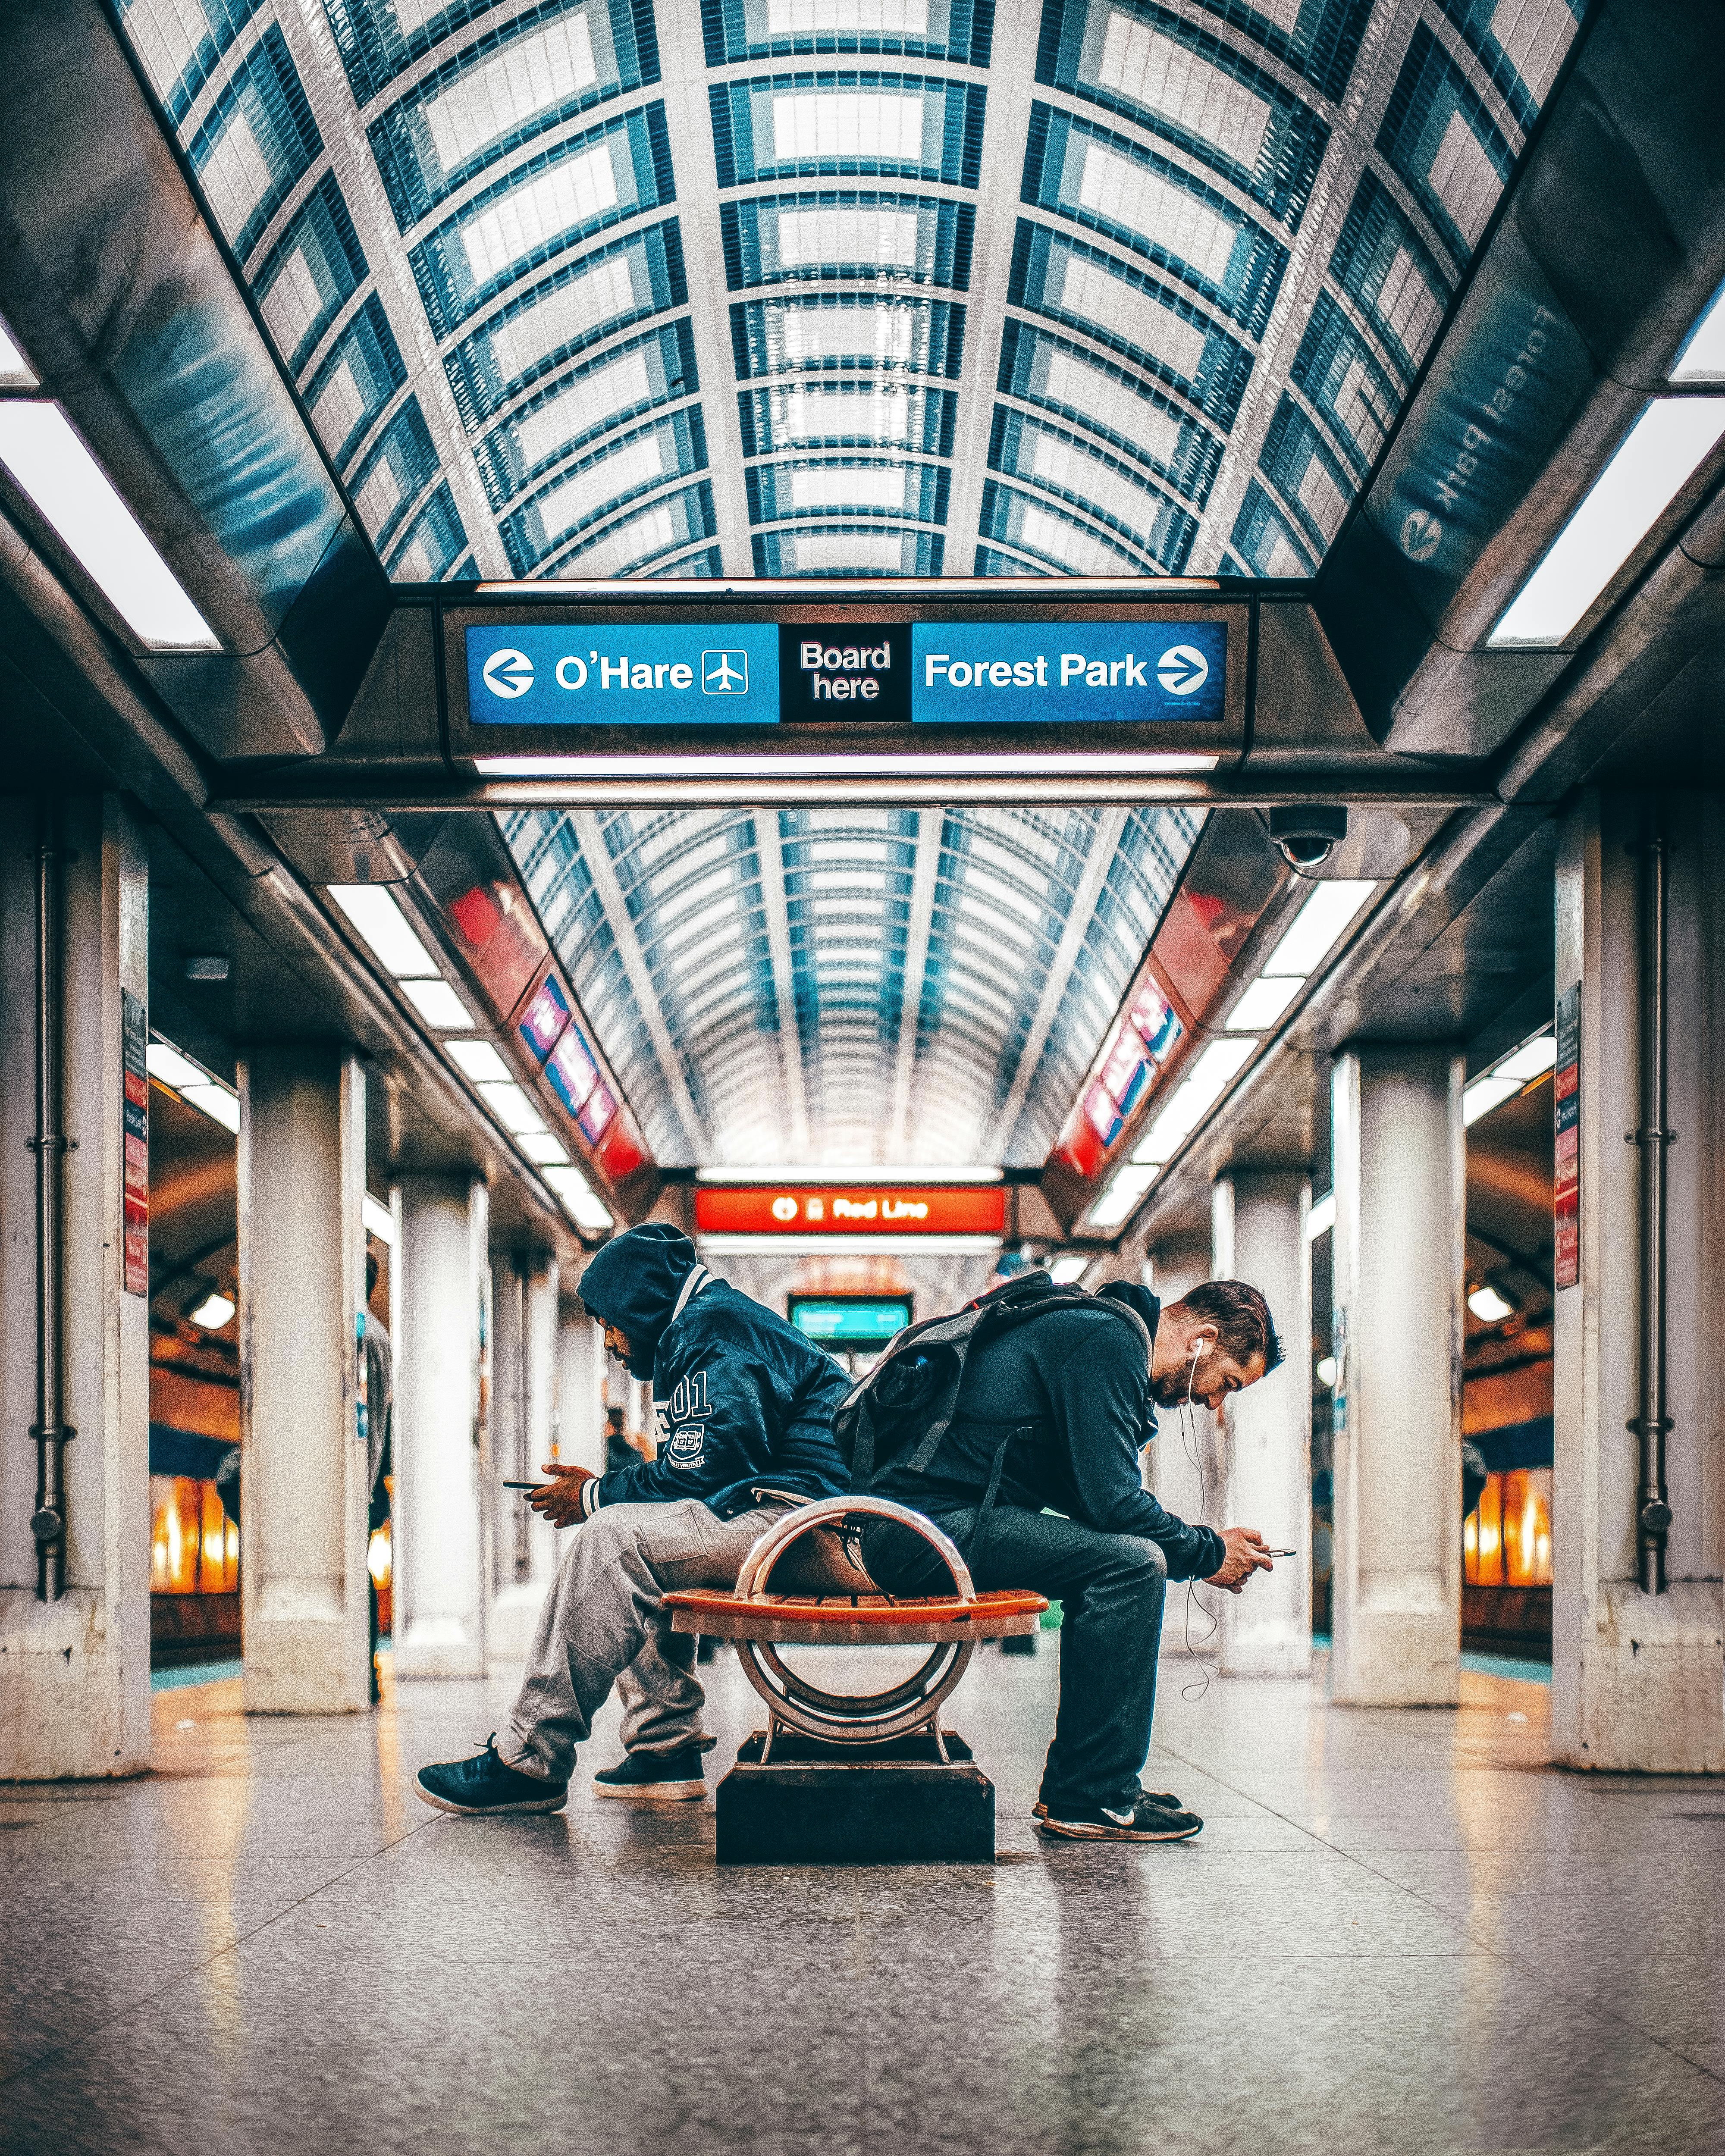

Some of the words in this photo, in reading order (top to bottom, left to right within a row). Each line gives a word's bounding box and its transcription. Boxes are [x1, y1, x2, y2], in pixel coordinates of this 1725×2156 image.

[555, 650, 693, 690] O'Hare
[801, 641, 891, 670] Board
[925, 654, 1048, 687] Forest
[1060, 653, 1148, 687] Park
[813, 673, 880, 700] here
[670, 1371, 712, 1423] 01
